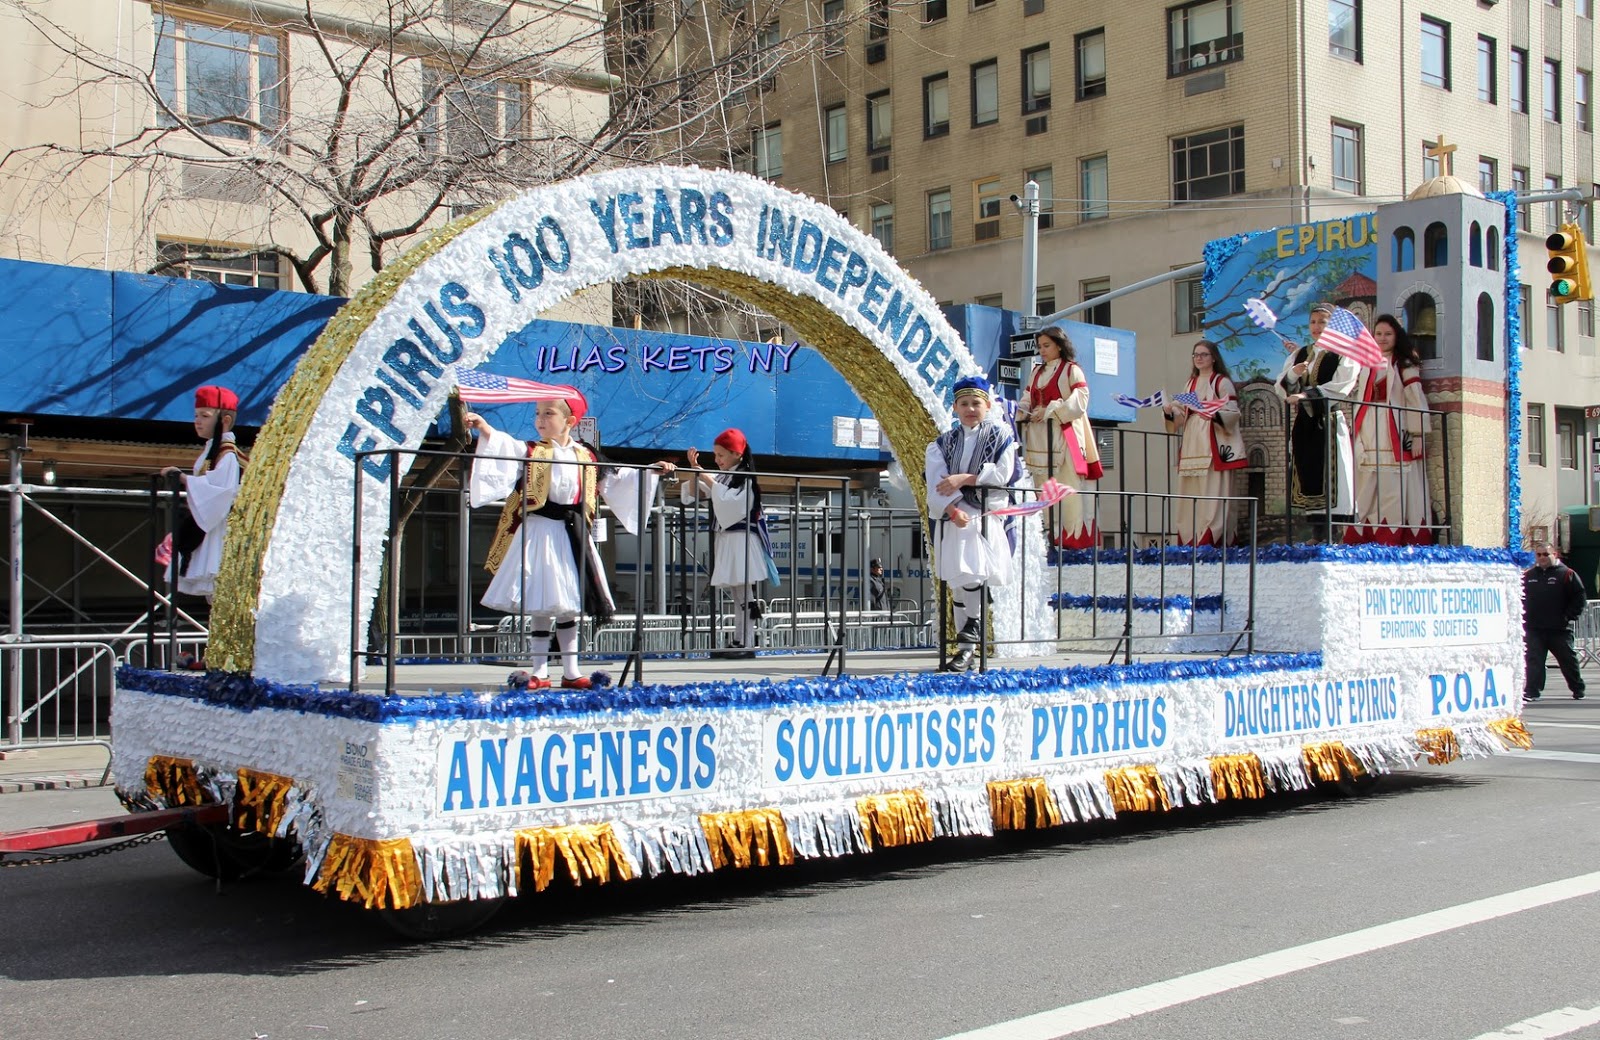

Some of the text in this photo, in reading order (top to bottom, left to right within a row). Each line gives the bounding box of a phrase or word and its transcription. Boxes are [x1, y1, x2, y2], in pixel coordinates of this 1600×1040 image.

[336, 188, 962, 484] EPIRUS 100 YEARS INDEPENDEN
[1003, 366, 1017, 377] ONE
[1365, 588, 1502, 616] PAN EPIROTIC FEDERATION
[1380, 618, 1479, 640] EPIROTANS SOCIETIES
[1224, 676, 1397, 738] DAUGHTERS OF EPIRUS
[1429, 668, 1507, 716] P.O.A.
[774, 706, 996, 782] SOULIOTISSES
[1030, 697, 1167, 760] PYRRHUS
[443, 723, 716, 811] ANAGENESIS
